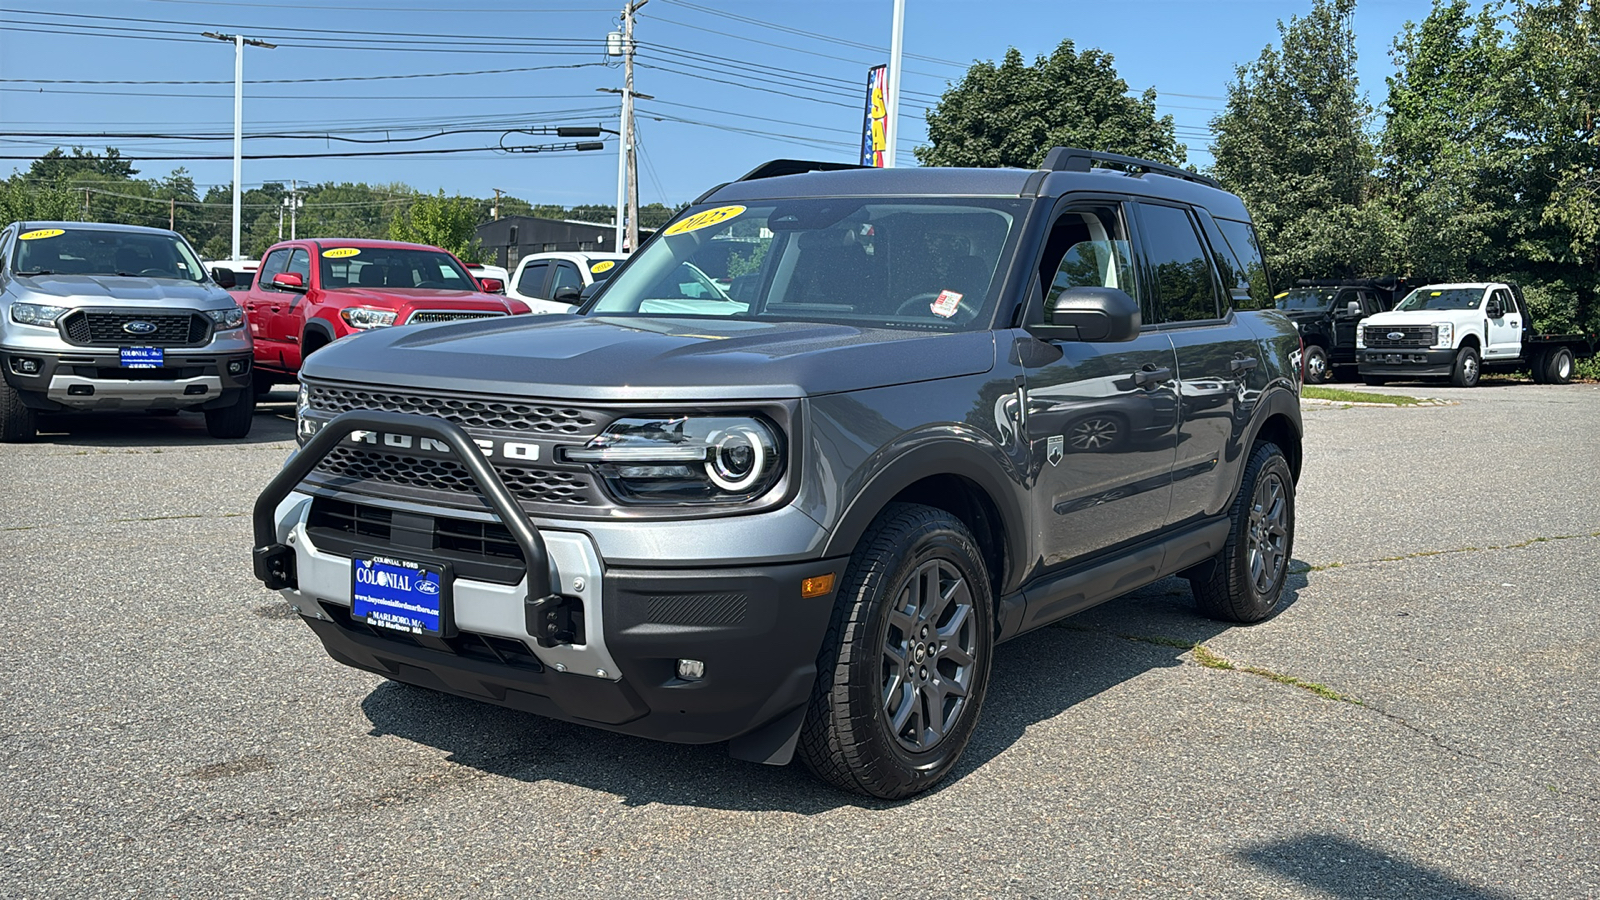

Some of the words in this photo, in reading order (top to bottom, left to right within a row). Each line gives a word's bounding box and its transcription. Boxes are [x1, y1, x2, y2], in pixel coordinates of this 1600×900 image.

[871, 87, 887, 167] SA
[671, 207, 735, 234] 2025
[322, 421, 540, 461] RONCO
[373, 556, 401, 567] COLONIAL
[402, 561, 419, 569] FORD
[356, 567, 412, 592] COLONIAL
[419, 581, 436, 593] Ford
[372, 611, 410, 626] MARLBORO,
[385, 621, 410, 632] Marlboro
